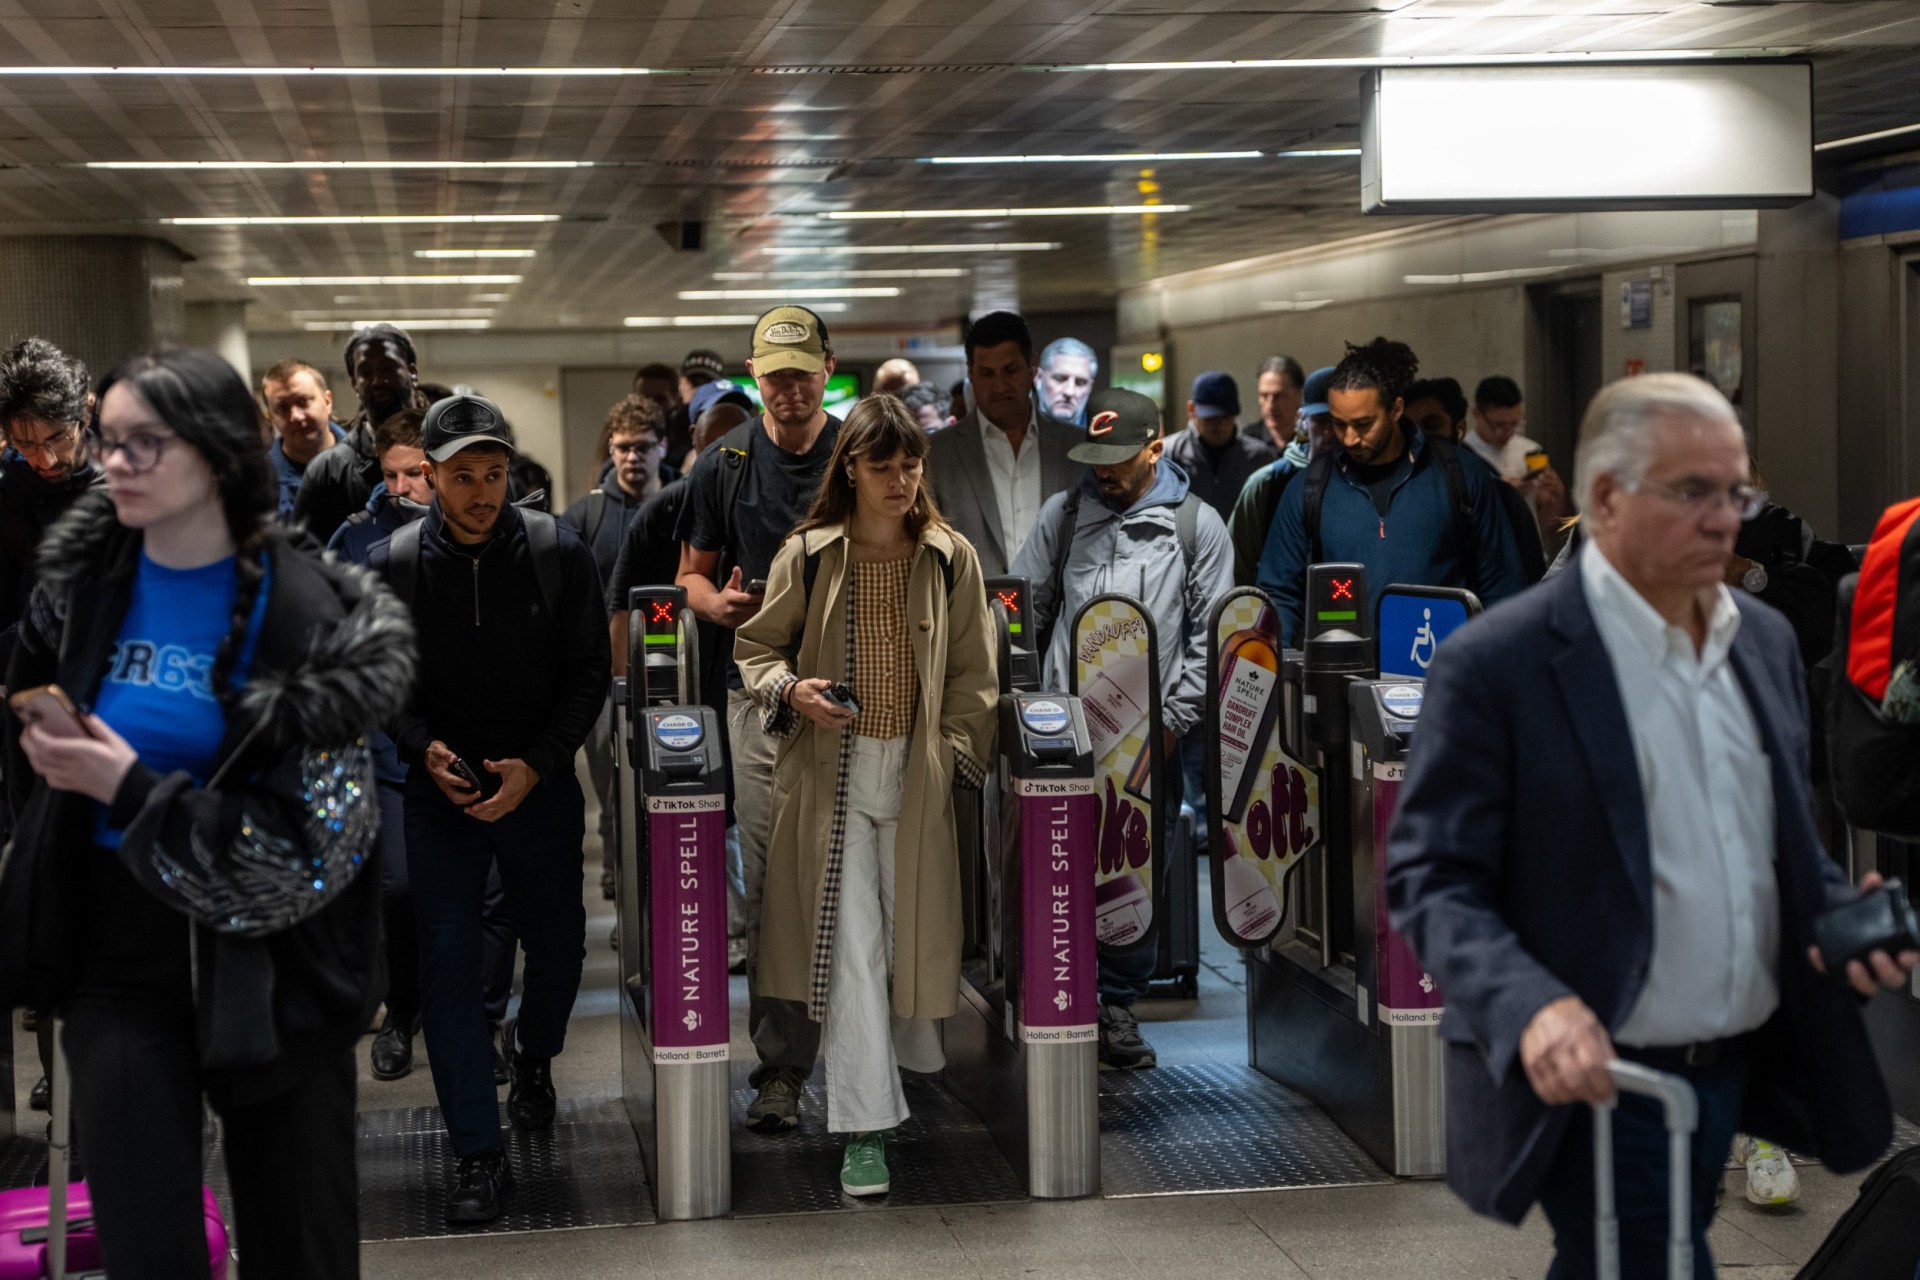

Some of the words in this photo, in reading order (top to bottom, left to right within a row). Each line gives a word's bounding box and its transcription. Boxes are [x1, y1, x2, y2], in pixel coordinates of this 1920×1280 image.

[781, 324, 802, 337] Dutch
[1089, 410, 1119, 437] C
[1235, 677, 1265, 695] NATURE
[1236, 686, 1257, 701] SPELL
[1227, 700, 1257, 719] DANDRUFF
[1222, 720, 1236, 735] HAIR
[1236, 727, 1246, 739] OIL
[1225, 710, 1252, 730] COMPLEX
[1035, 784, 1067, 793] TikTok
[1069, 783, 1090, 793] Shop
[663, 801, 695, 809] TikTok
[698, 800, 720, 809] Shop
[1051, 801, 1068, 871] SPELL
[680, 817, 698, 889] SPELL
[1053, 884, 1070, 981] NATURE
[681, 902, 700, 1000] NATURE
